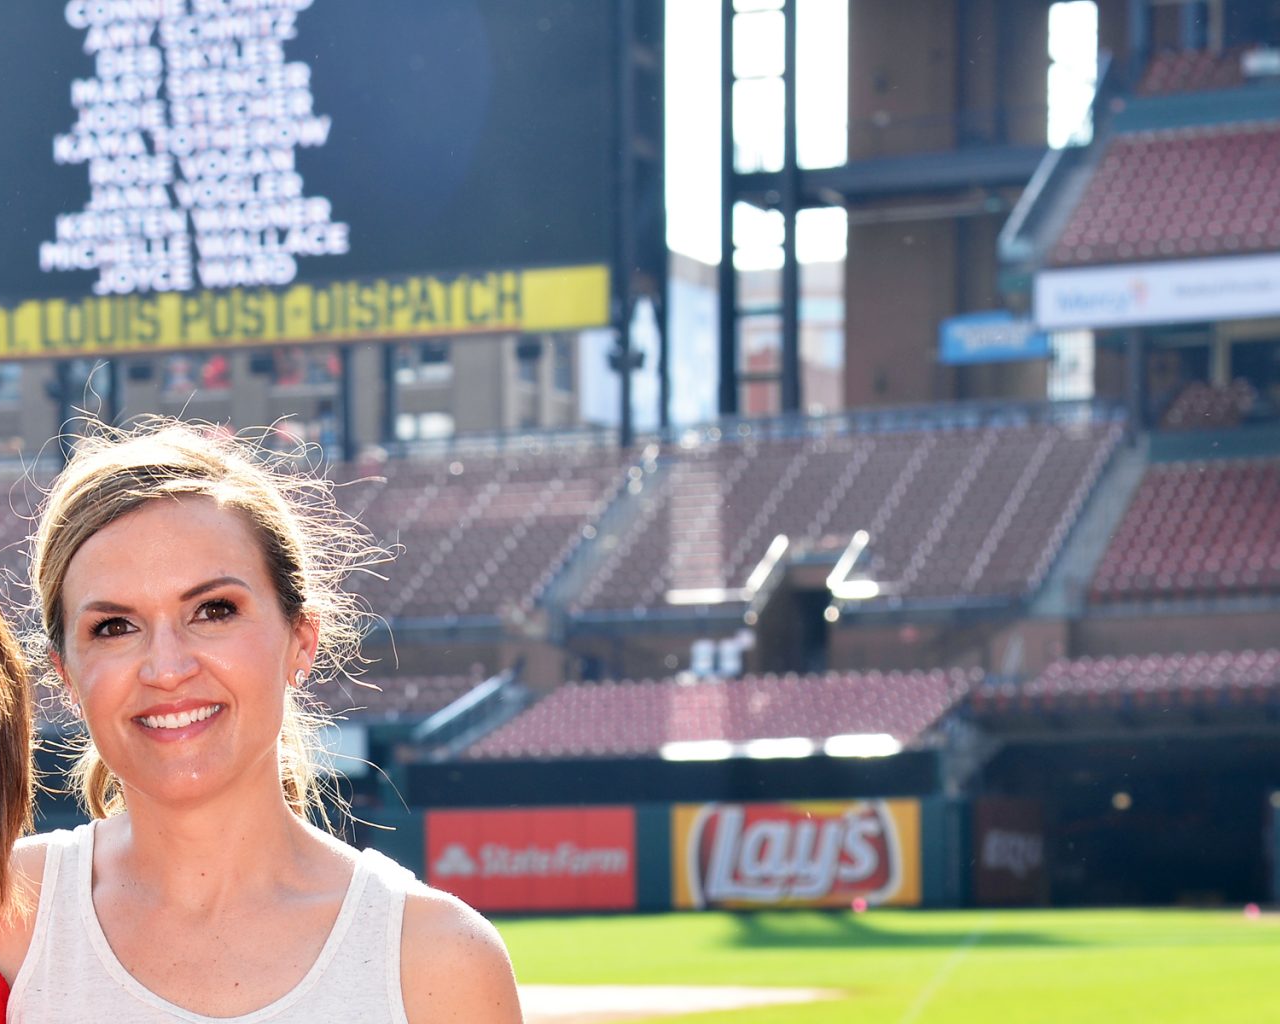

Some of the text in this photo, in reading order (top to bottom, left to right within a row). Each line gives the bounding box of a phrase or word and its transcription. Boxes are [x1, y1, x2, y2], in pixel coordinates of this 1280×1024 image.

[42, 224, 348, 270] MICHELLE WALLACE
[95, 264, 192, 293] JOYCE
[38, 296, 163, 349] LOUIS
[179, 272, 523, 340] POST-DISPATCH
[705, 806, 881, 900] Lay's
